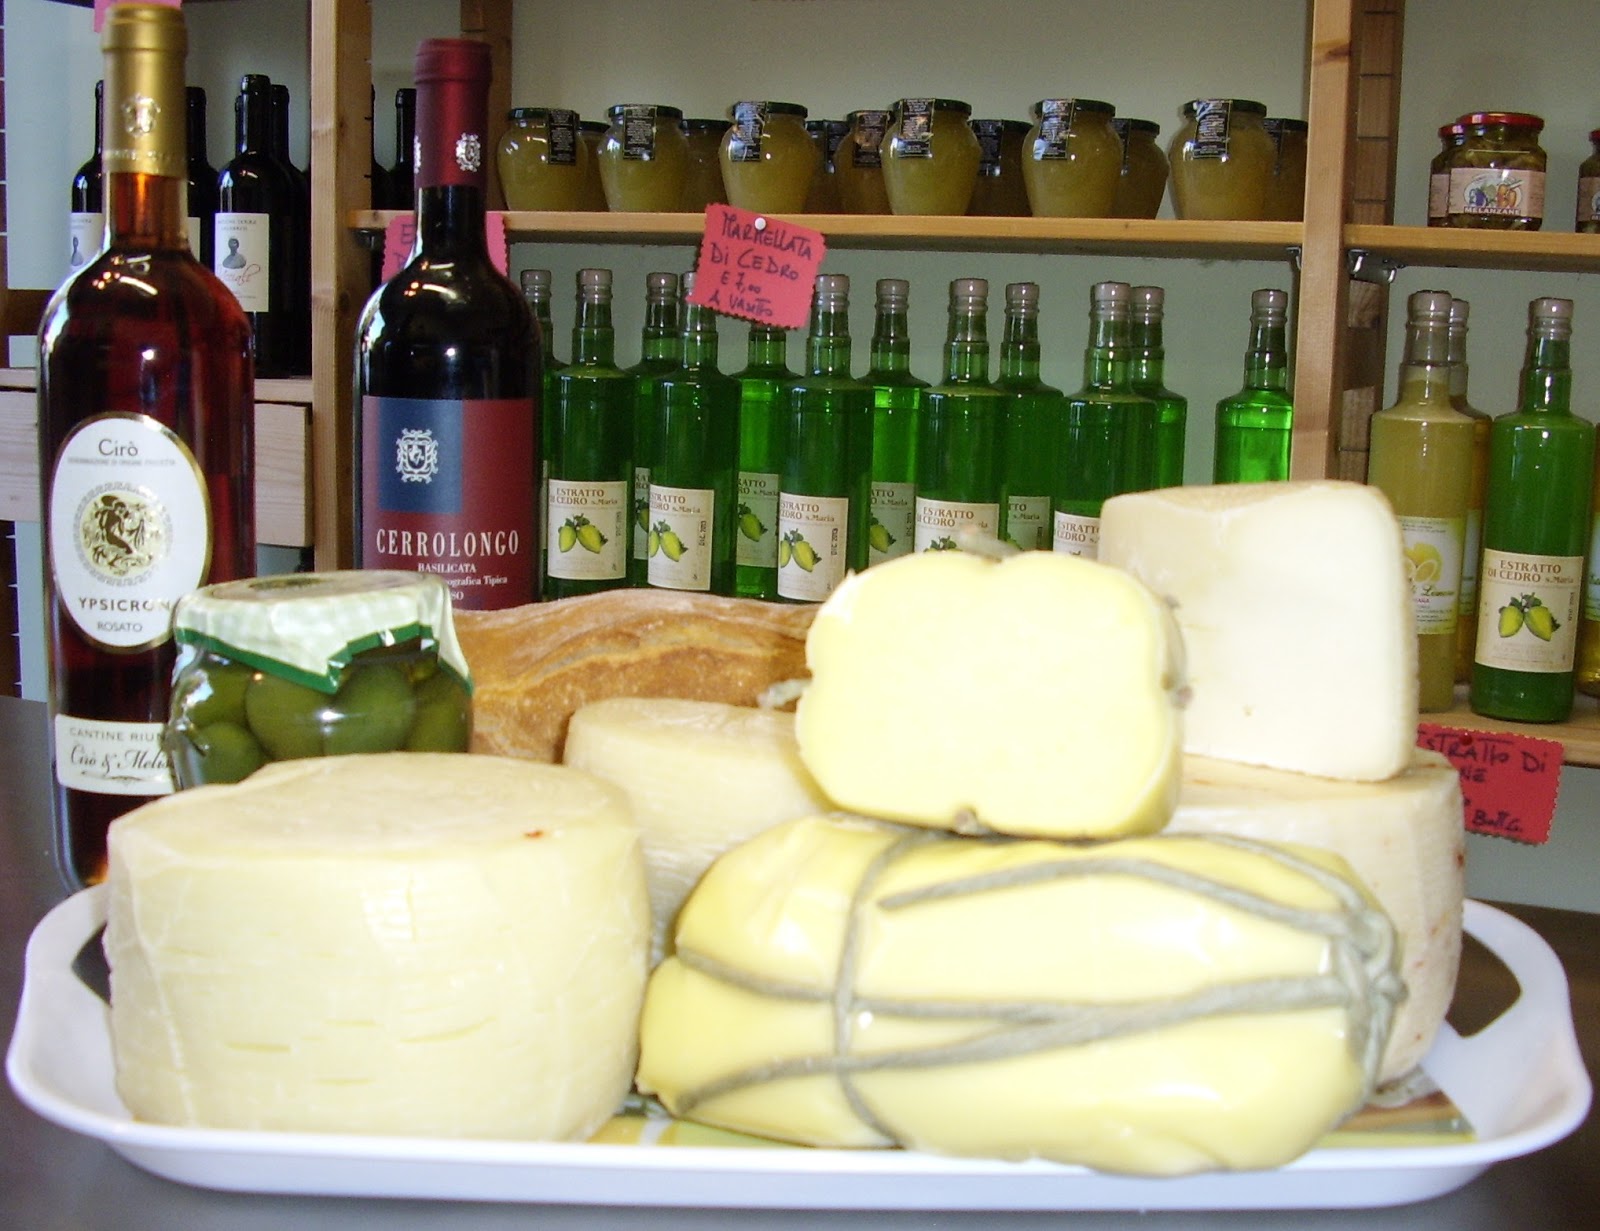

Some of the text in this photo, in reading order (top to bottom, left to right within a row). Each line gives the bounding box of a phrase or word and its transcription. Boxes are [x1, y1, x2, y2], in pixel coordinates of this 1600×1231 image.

[1464, 207, 1521, 215] MELANZANE
[737, 248, 799, 280] CEDRO
[98, 438, 138, 456] Cirò
[556, 488, 605, 497] ESTRATTO
[650, 492, 686, 504] STRATTO
[556, 497, 588, 505] CEDRO
[781, 501, 820, 512] STRATTO
[923, 506, 974, 519] ESTRATTO
[923, 515, 956, 527] CEDRO
[376, 528, 519, 557] CERROLONGO
[418, 563, 477, 573] BASILICATA
[1500, 560, 1562, 573] ESTRATTO
[447, 575, 508, 588] ografica Tipica
[1500, 571, 1541, 582] CEDRO
[97, 621, 143, 632] ROSATO
[69, 727, 125, 741] CANTINE
